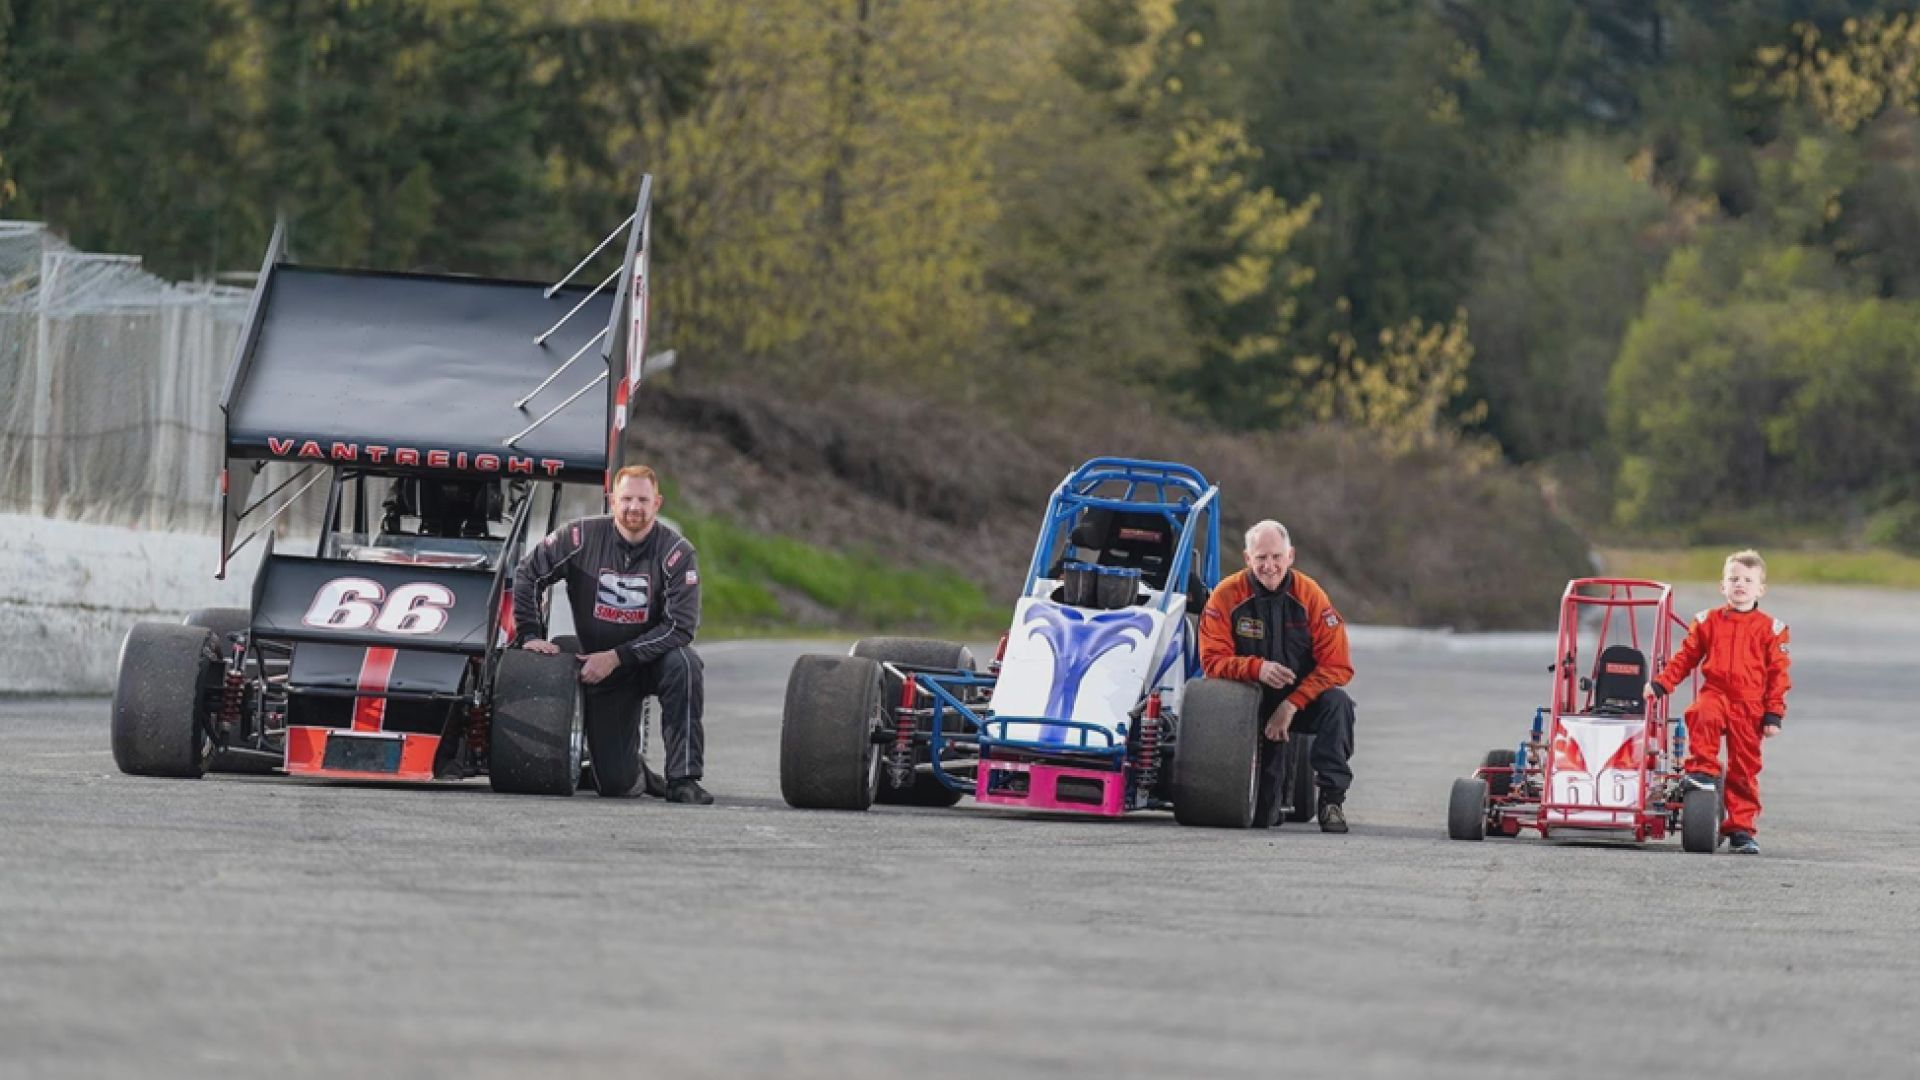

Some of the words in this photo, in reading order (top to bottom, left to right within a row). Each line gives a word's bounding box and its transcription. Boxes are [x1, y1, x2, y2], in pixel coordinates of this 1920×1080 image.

[267, 437, 564, 476] VANTREIGHT
[301, 576, 456, 634] 66
[595, 604, 648, 623] SIMPSON
[1551, 768, 1639, 814] 66
